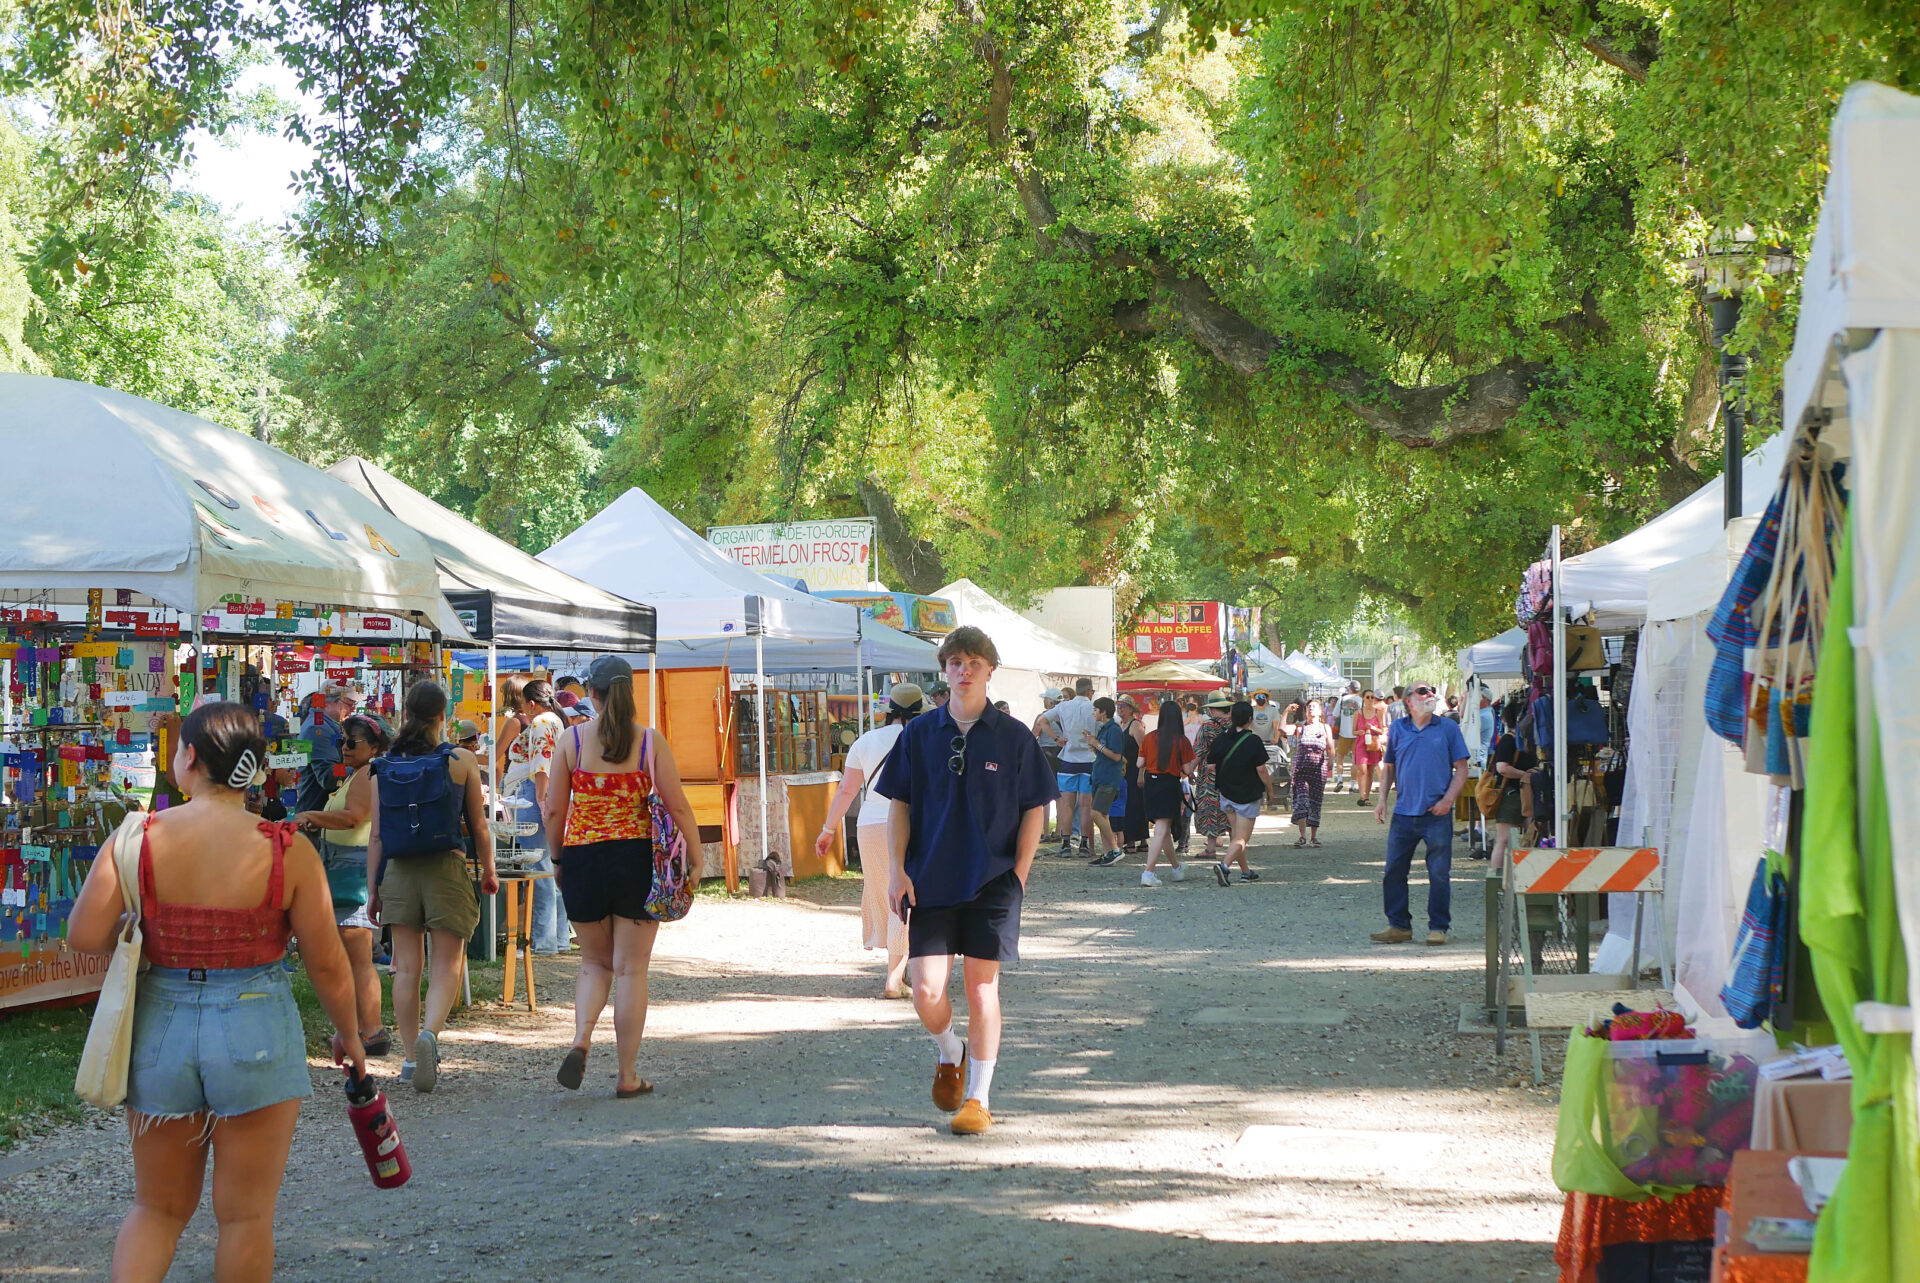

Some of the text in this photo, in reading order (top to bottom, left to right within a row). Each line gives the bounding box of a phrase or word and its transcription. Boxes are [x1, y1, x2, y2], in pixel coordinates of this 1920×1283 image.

[713, 529, 764, 545] ORGANIC
[813, 542, 859, 563] FROST
[1134, 625, 1212, 634] AVA AND COFFEE
[115, 694, 137, 702] LOVE
[275, 757, 302, 765] DREAM
[0, 968, 19, 990] ove
[23, 964, 47, 985] into
[51, 954, 71, 981] the
